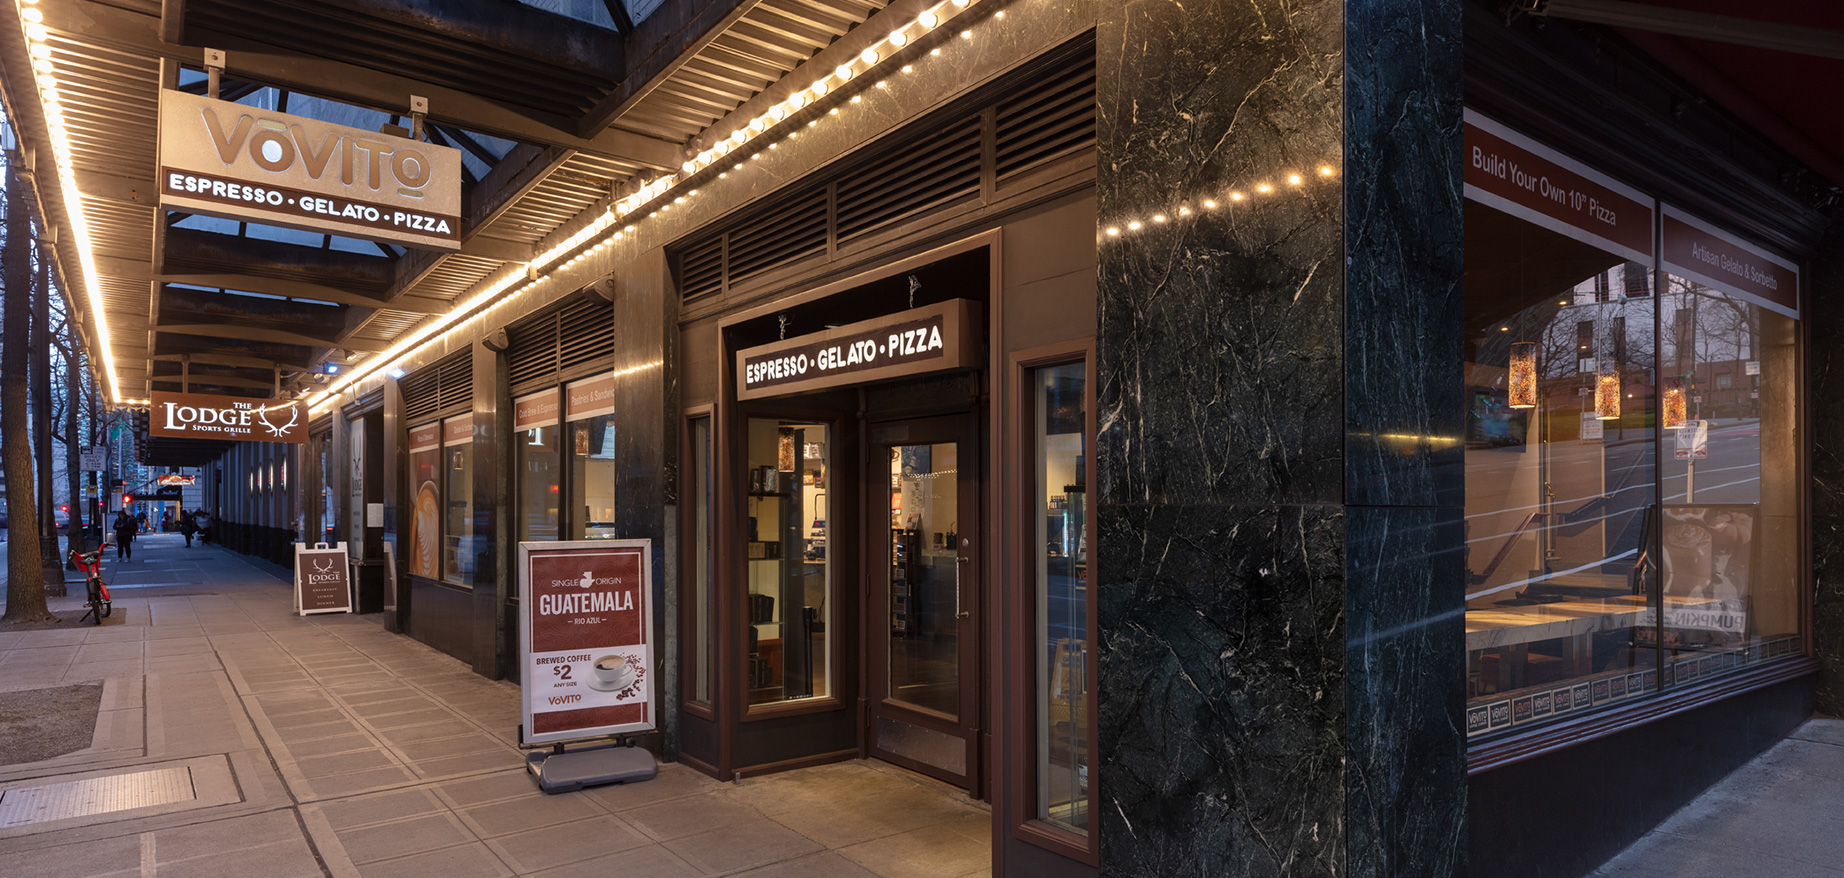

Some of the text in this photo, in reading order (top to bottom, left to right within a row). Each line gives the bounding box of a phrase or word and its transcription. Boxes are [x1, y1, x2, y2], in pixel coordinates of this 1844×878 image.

[1472, 145, 1506, 180] Build
[1509, 161, 1537, 193] Your
[1540, 176, 1566, 205] Own
[1589, 197, 1617, 226] Pizza
[169, 173, 451, 235] ESPRESSO GELATO PIZZA
[1692, 241, 1777, 291] Artisan Gelato & Sorbetto
[746, 325, 943, 384] ESPRESSO GELATO PIZZA
[570, 394, 589, 407] Pastries
[594, 386, 614, 401] Sandwic
[233, 401, 252, 410] THE
[527, 407, 537, 418] Brew
[163, 401, 252, 430] LODGE
[192, 424, 222, 432] SPORTS
[308, 574, 341, 585] LODGE
[551, 577, 622, 588] SINGLE ORIGIN
[539, 590, 634, 616] GUATEMALA
[574, 616, 601, 625] RIO AZUL
[536, 654, 592, 665] BREWED COFFEE
[553, 664, 572, 680] $2
